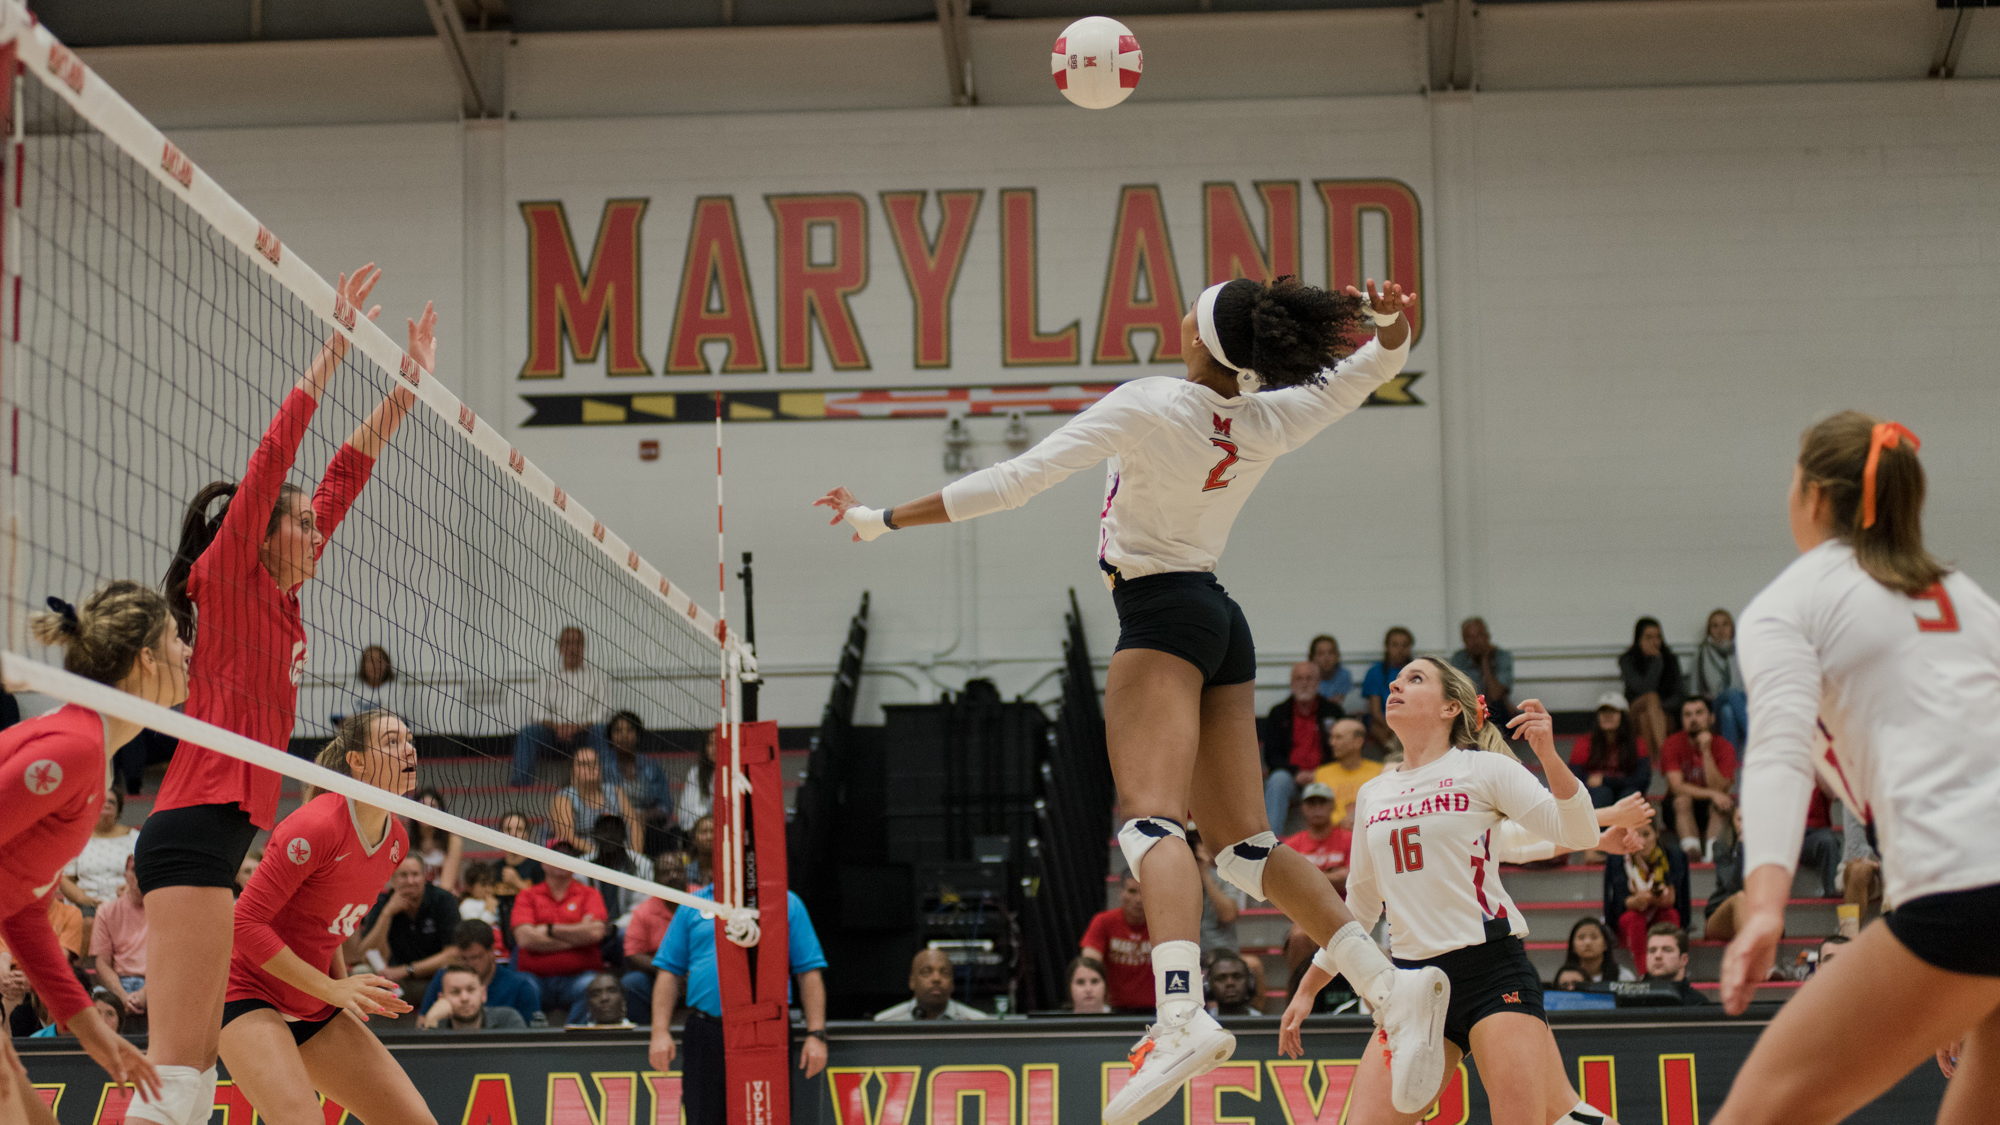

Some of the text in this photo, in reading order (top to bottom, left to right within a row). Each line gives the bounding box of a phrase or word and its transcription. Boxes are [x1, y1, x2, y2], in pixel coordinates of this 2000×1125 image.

[517, 177, 1424, 381] MARYLAND
[1212, 411, 1233, 436] M
[1202, 437, 1240, 492] 2
[1389, 825, 1424, 874] 16
